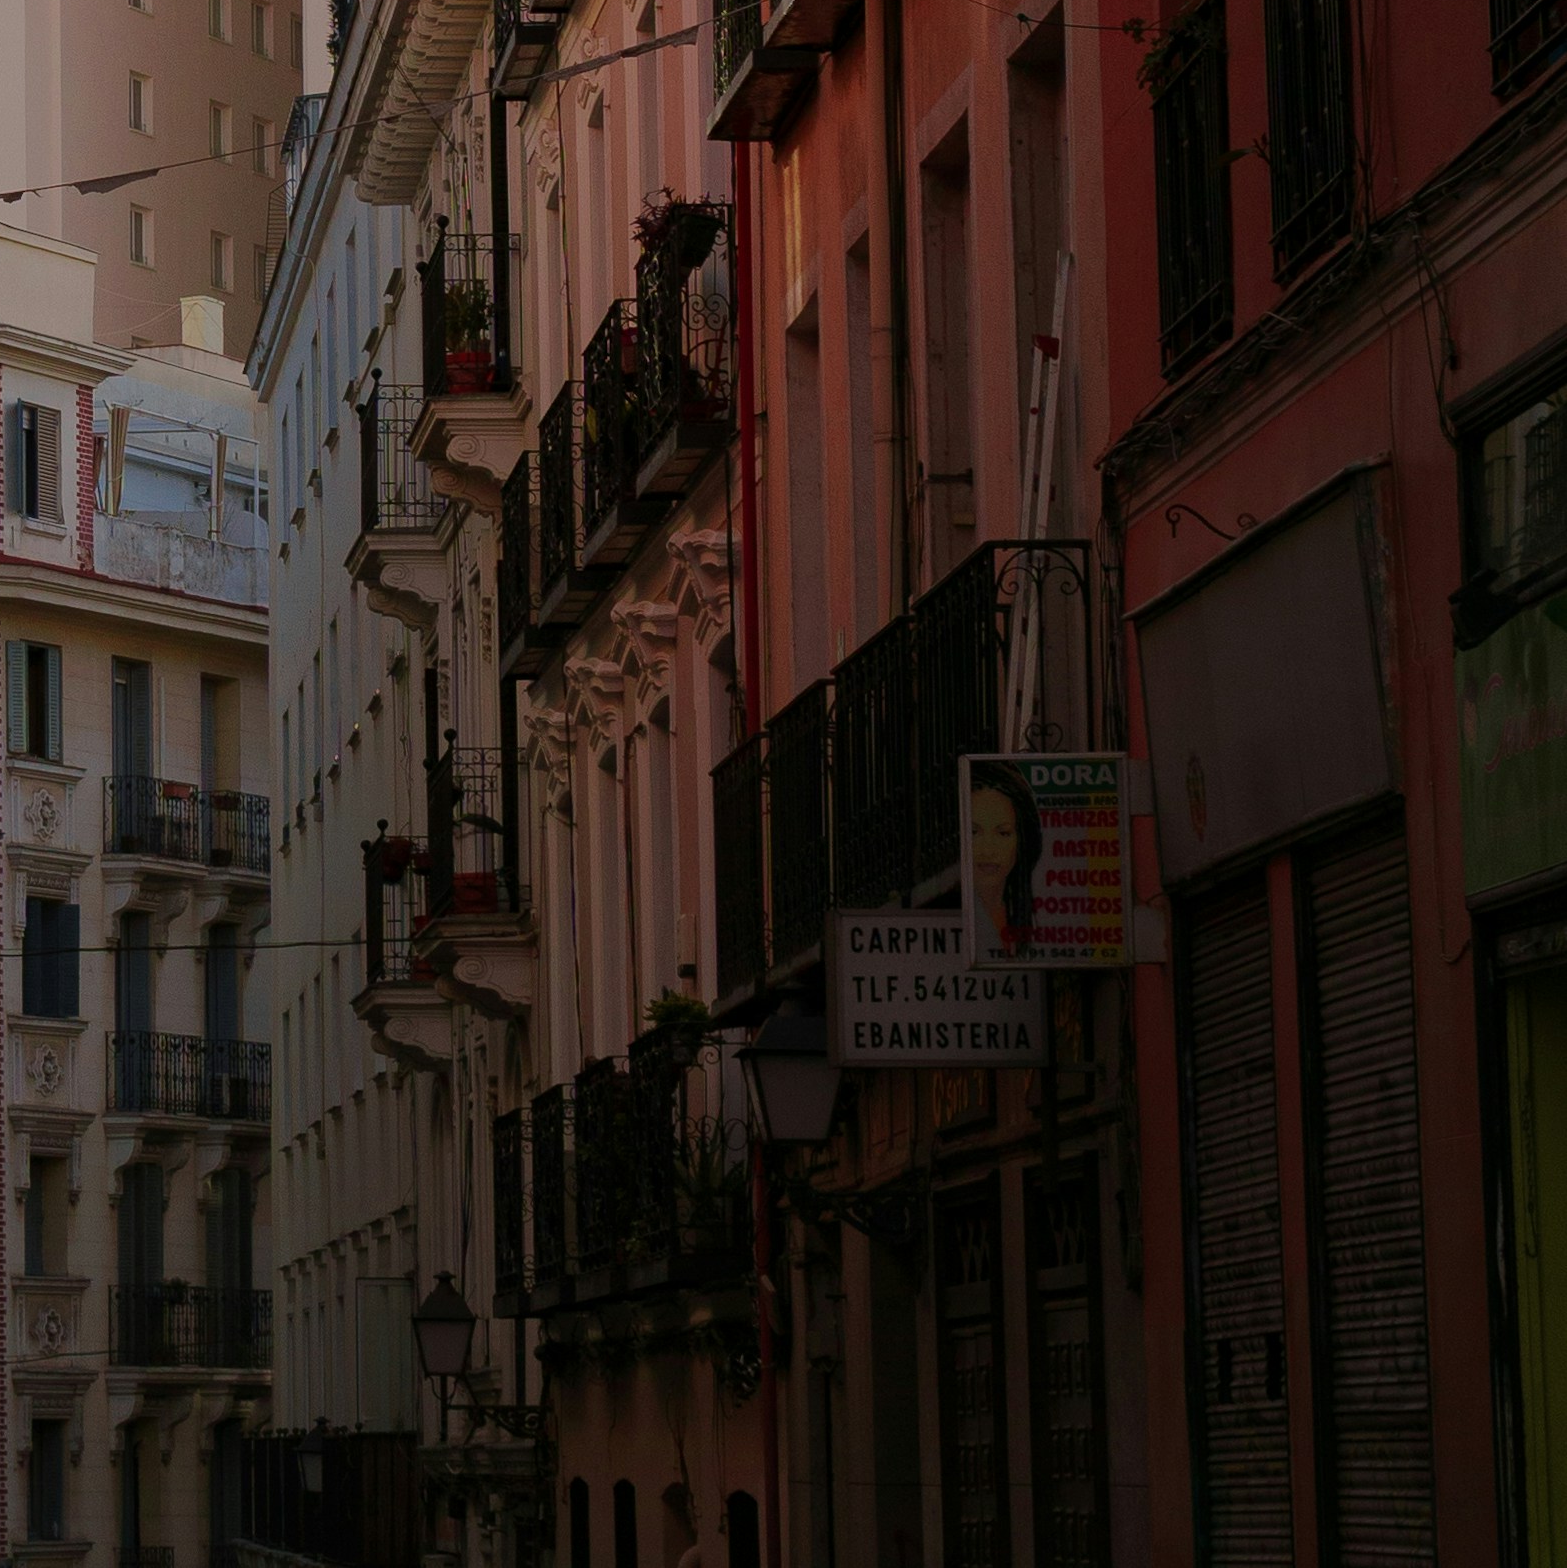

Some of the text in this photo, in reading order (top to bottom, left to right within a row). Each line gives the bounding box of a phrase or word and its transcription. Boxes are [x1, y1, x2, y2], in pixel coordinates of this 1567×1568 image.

[1030, 764, 1116, 786] DORA
[1040, 809, 1120, 828] TRENZAS
[1053, 840, 1120, 858] RASTAS
[1046, 869, 1121, 887] PELUCAS
[1031, 896, 1122, 915] POSTIZOS
[1051, 947, 1075, 959] 542
[1080, 947, 1097, 959] 47
[1101, 947, 1118, 959] 62
[854, 1021, 1031, 1049] EBANISTERIA
